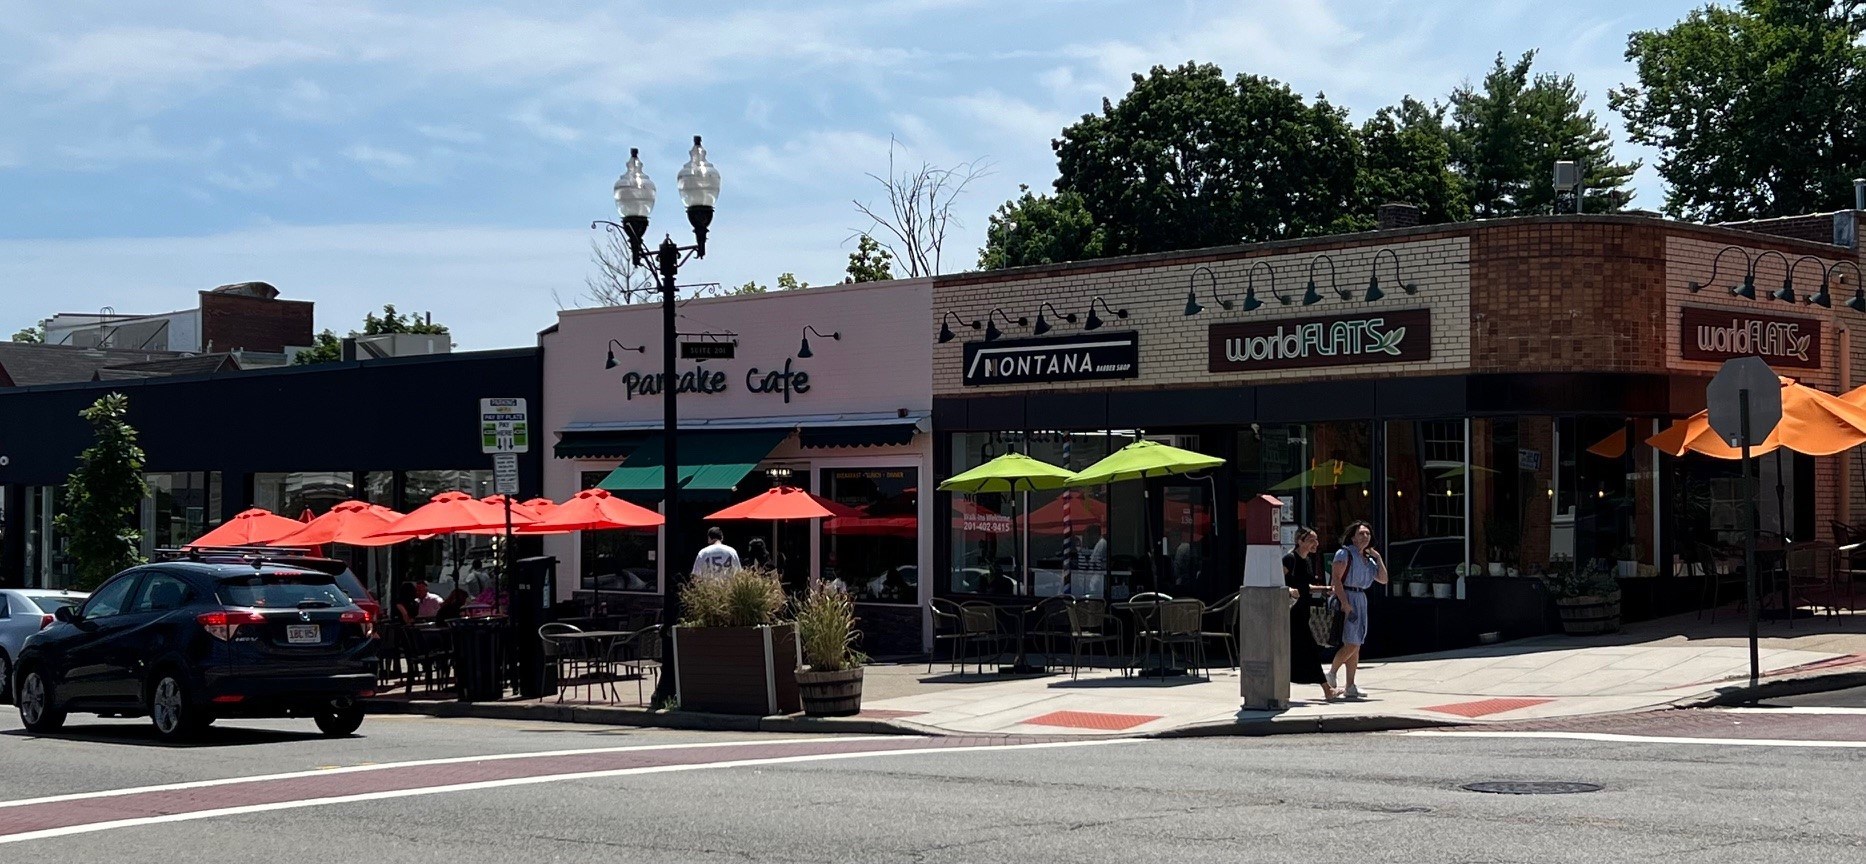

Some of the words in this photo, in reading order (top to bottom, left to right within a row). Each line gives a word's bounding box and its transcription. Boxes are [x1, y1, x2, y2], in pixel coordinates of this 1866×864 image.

[984, 352, 1093, 378] MONTANA
[1116, 363, 1131, 371] SHOP
[745, 357, 811, 404] Cafe
[963, 521, 1011, 532] 201-402-9415
